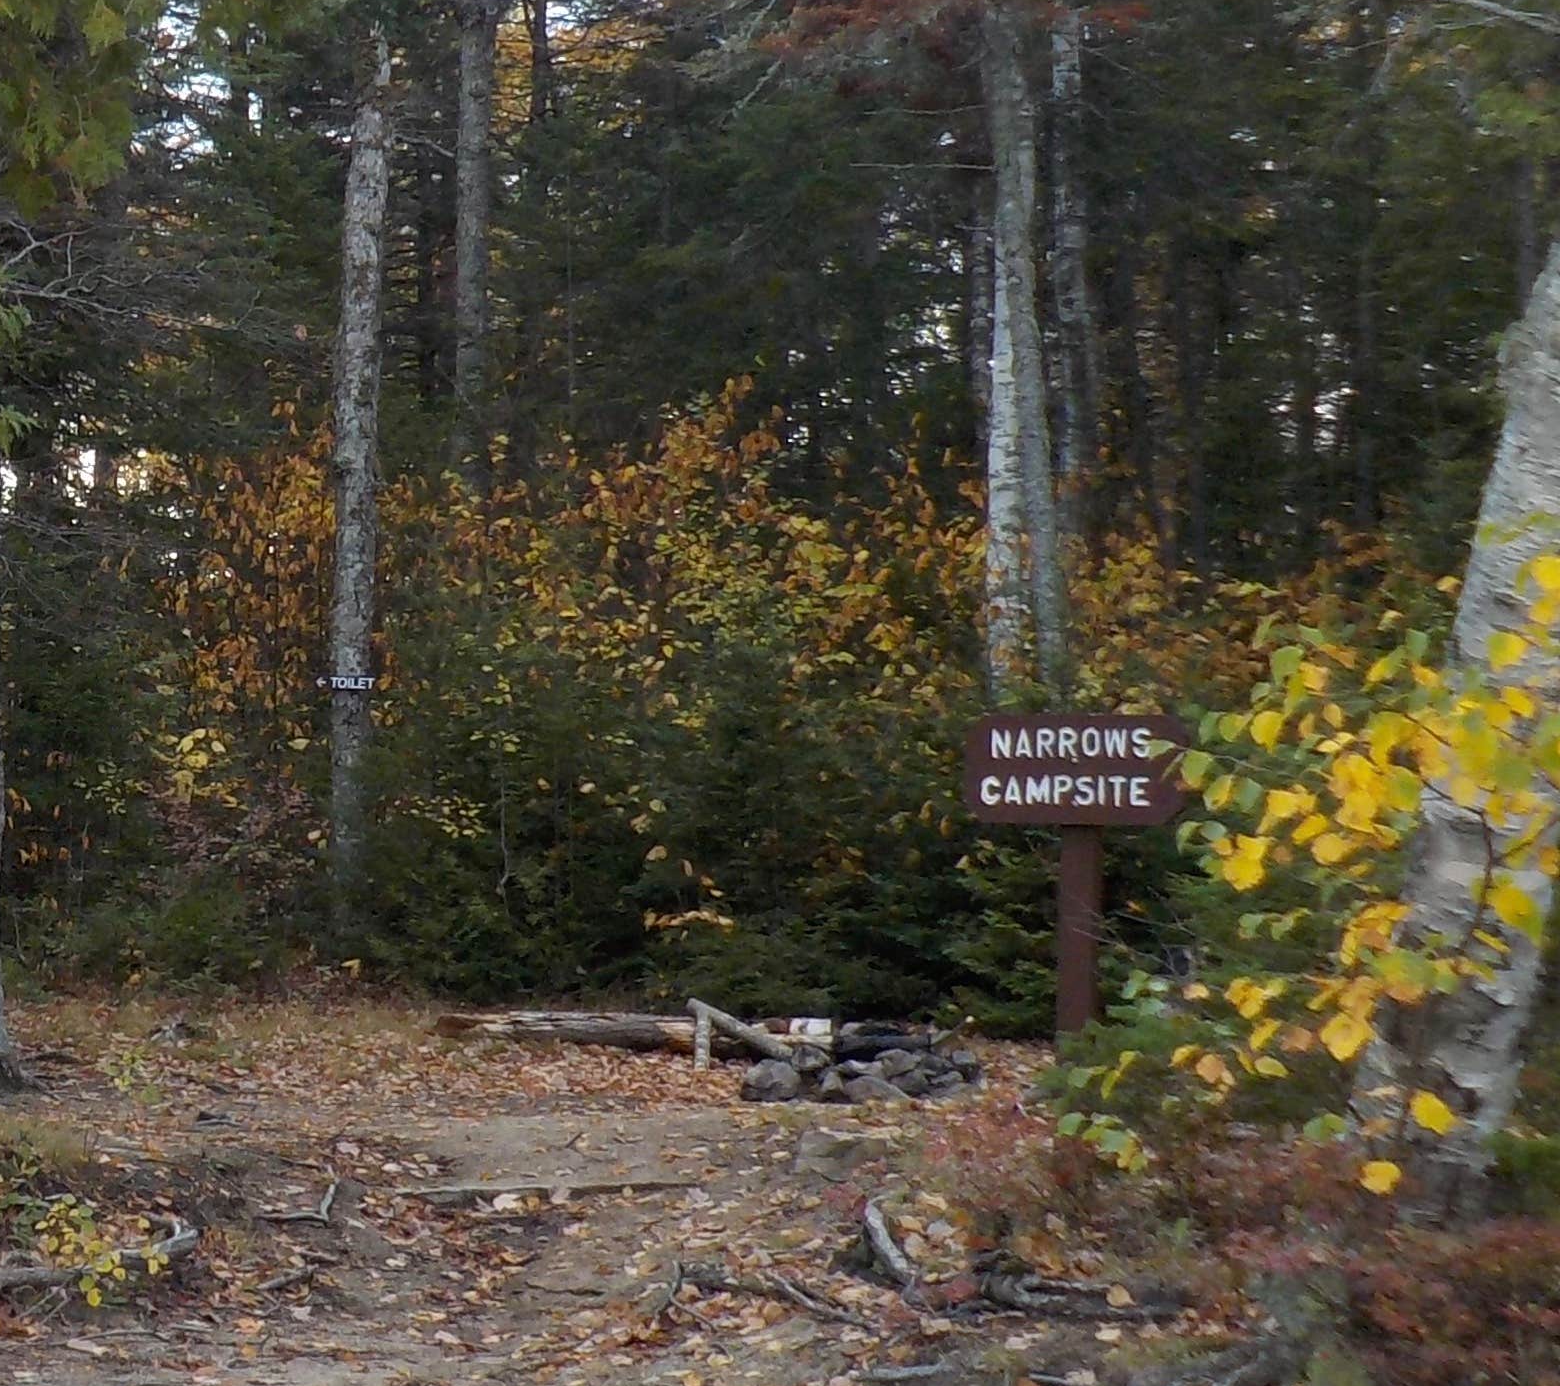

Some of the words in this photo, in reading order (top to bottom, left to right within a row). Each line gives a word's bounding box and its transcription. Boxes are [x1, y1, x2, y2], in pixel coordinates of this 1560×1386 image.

[329, 676, 375, 689] TOILET
[991, 727, 1152, 760] NARROWS
[980, 775, 1152, 807] CAMPSITE
